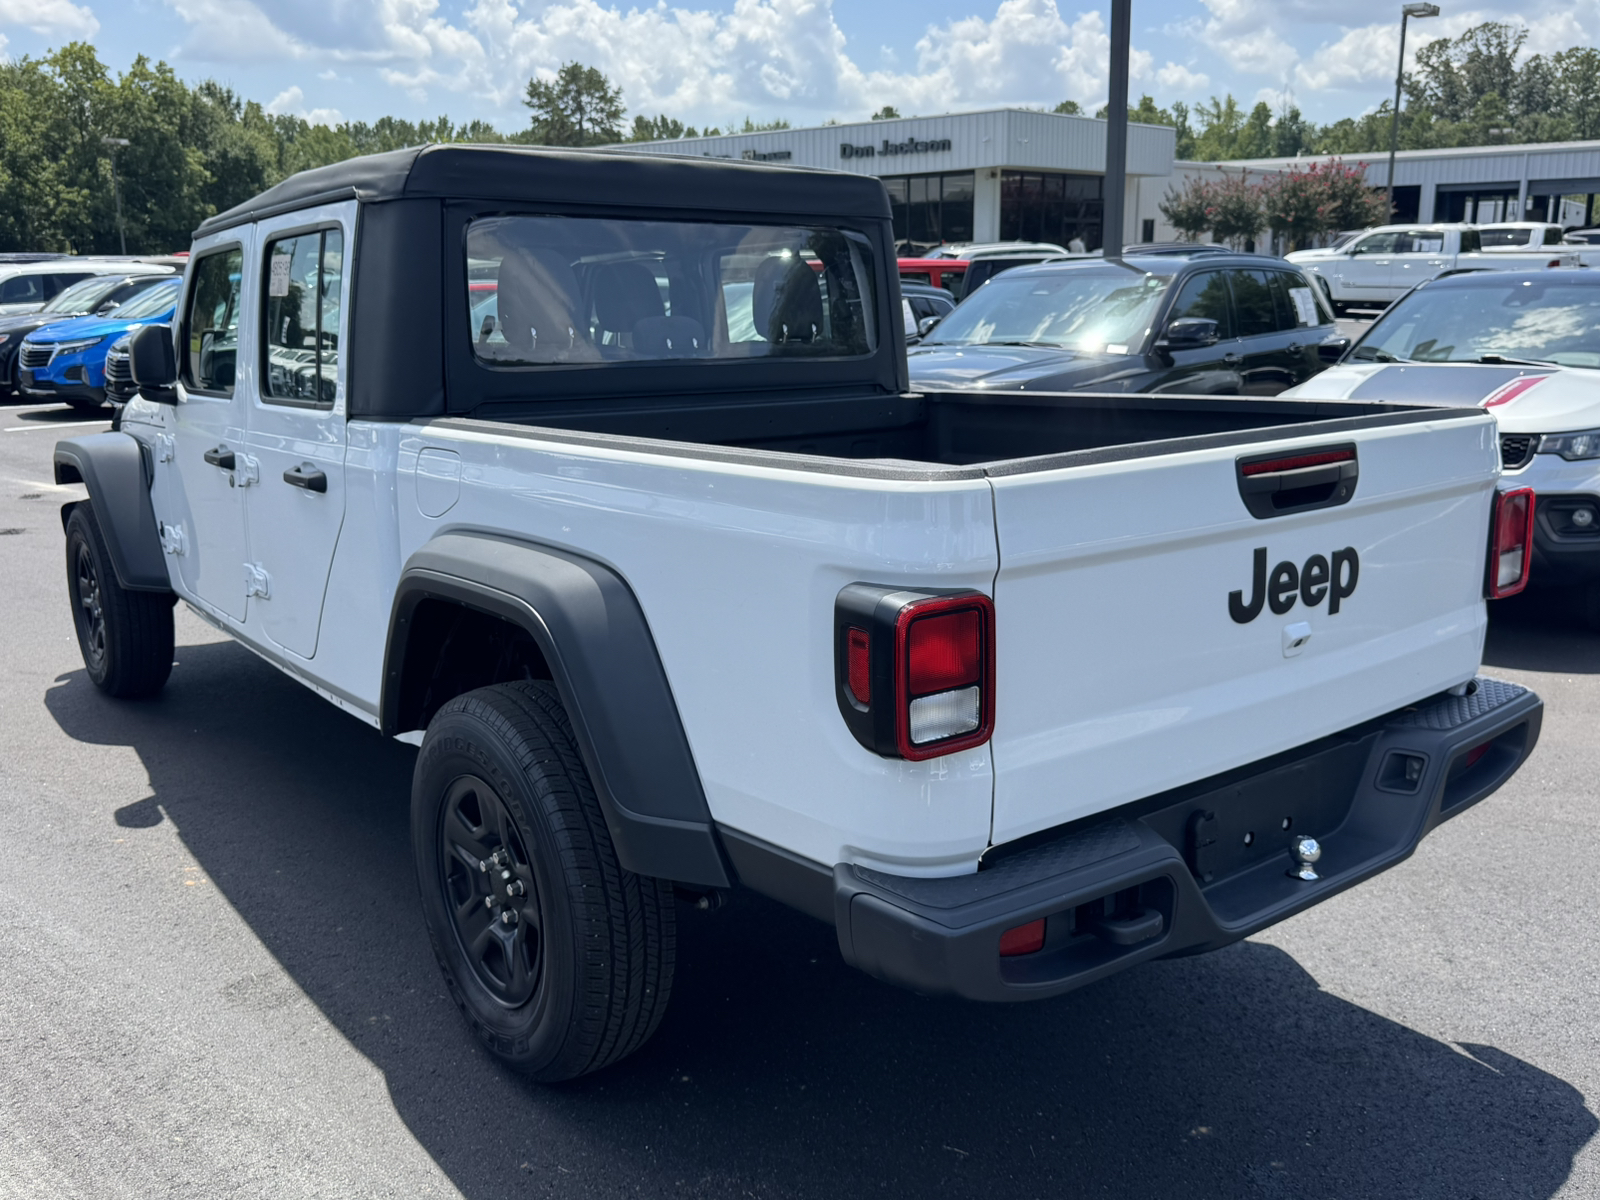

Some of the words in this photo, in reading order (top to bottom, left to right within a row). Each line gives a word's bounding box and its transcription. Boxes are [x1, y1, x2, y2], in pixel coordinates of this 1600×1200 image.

[840, 143, 875, 159] Don
[876, 138, 952, 157] Jackson
[1228, 546, 1359, 624] Jeep
